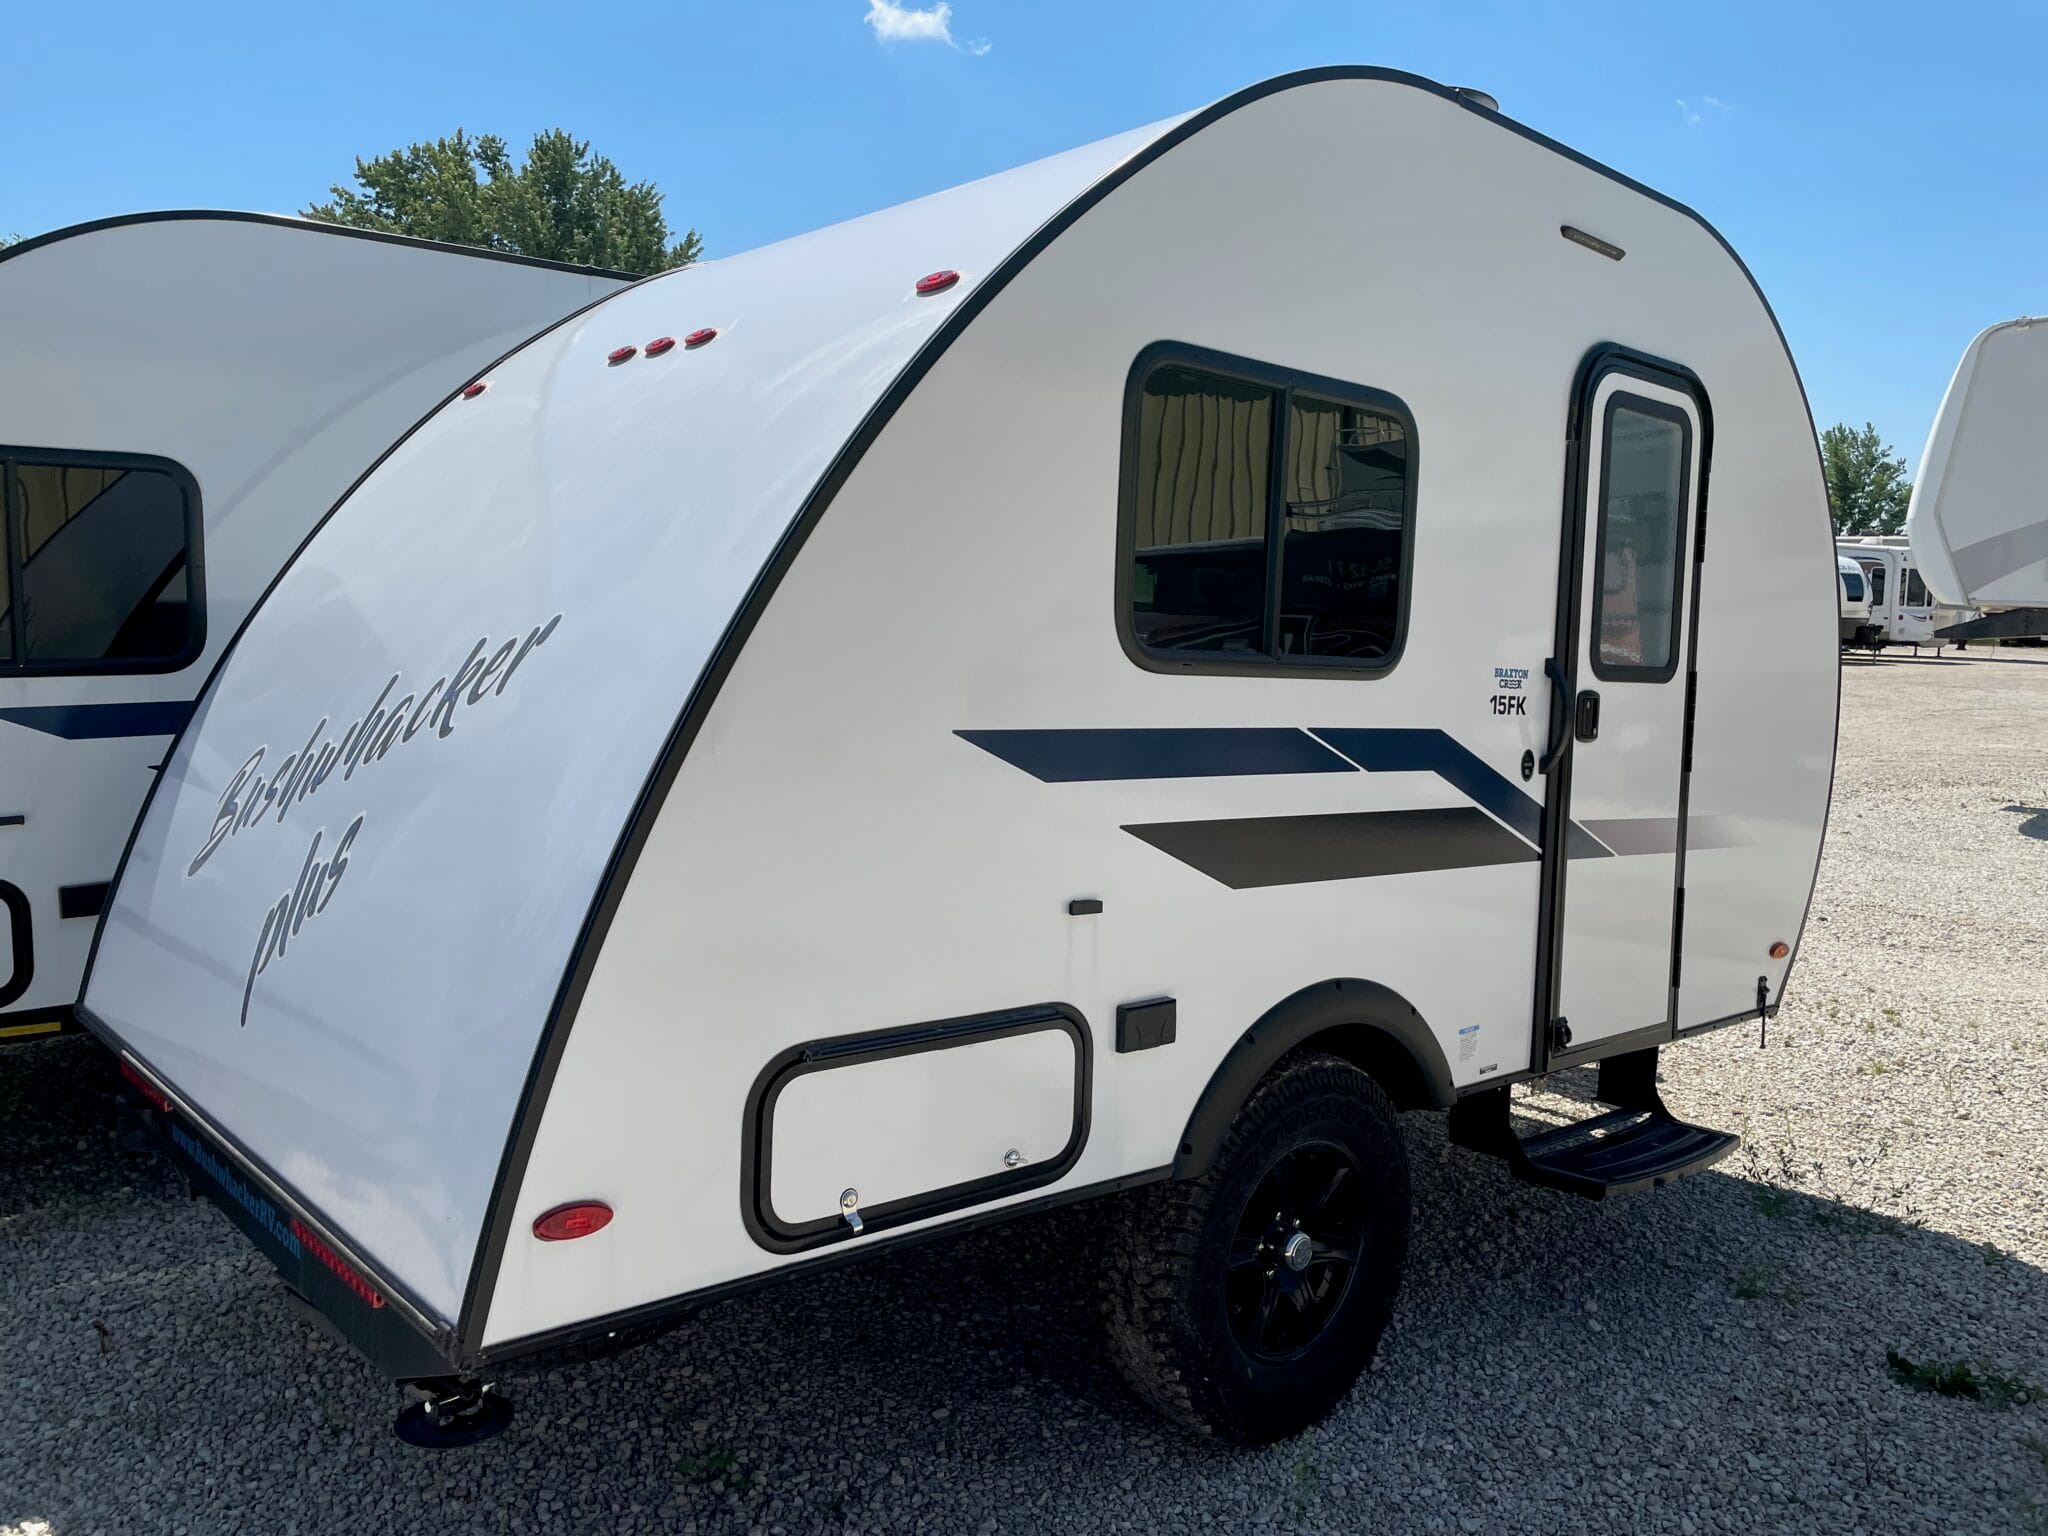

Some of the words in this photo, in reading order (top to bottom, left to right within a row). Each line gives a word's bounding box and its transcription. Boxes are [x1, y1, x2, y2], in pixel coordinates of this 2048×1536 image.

[1490, 694, 1527, 715] 15FK
[1494, 667, 1529, 679] BRAXTON
[187, 613, 563, 878] Bushwhacker
[240, 815, 364, 1028] plus
